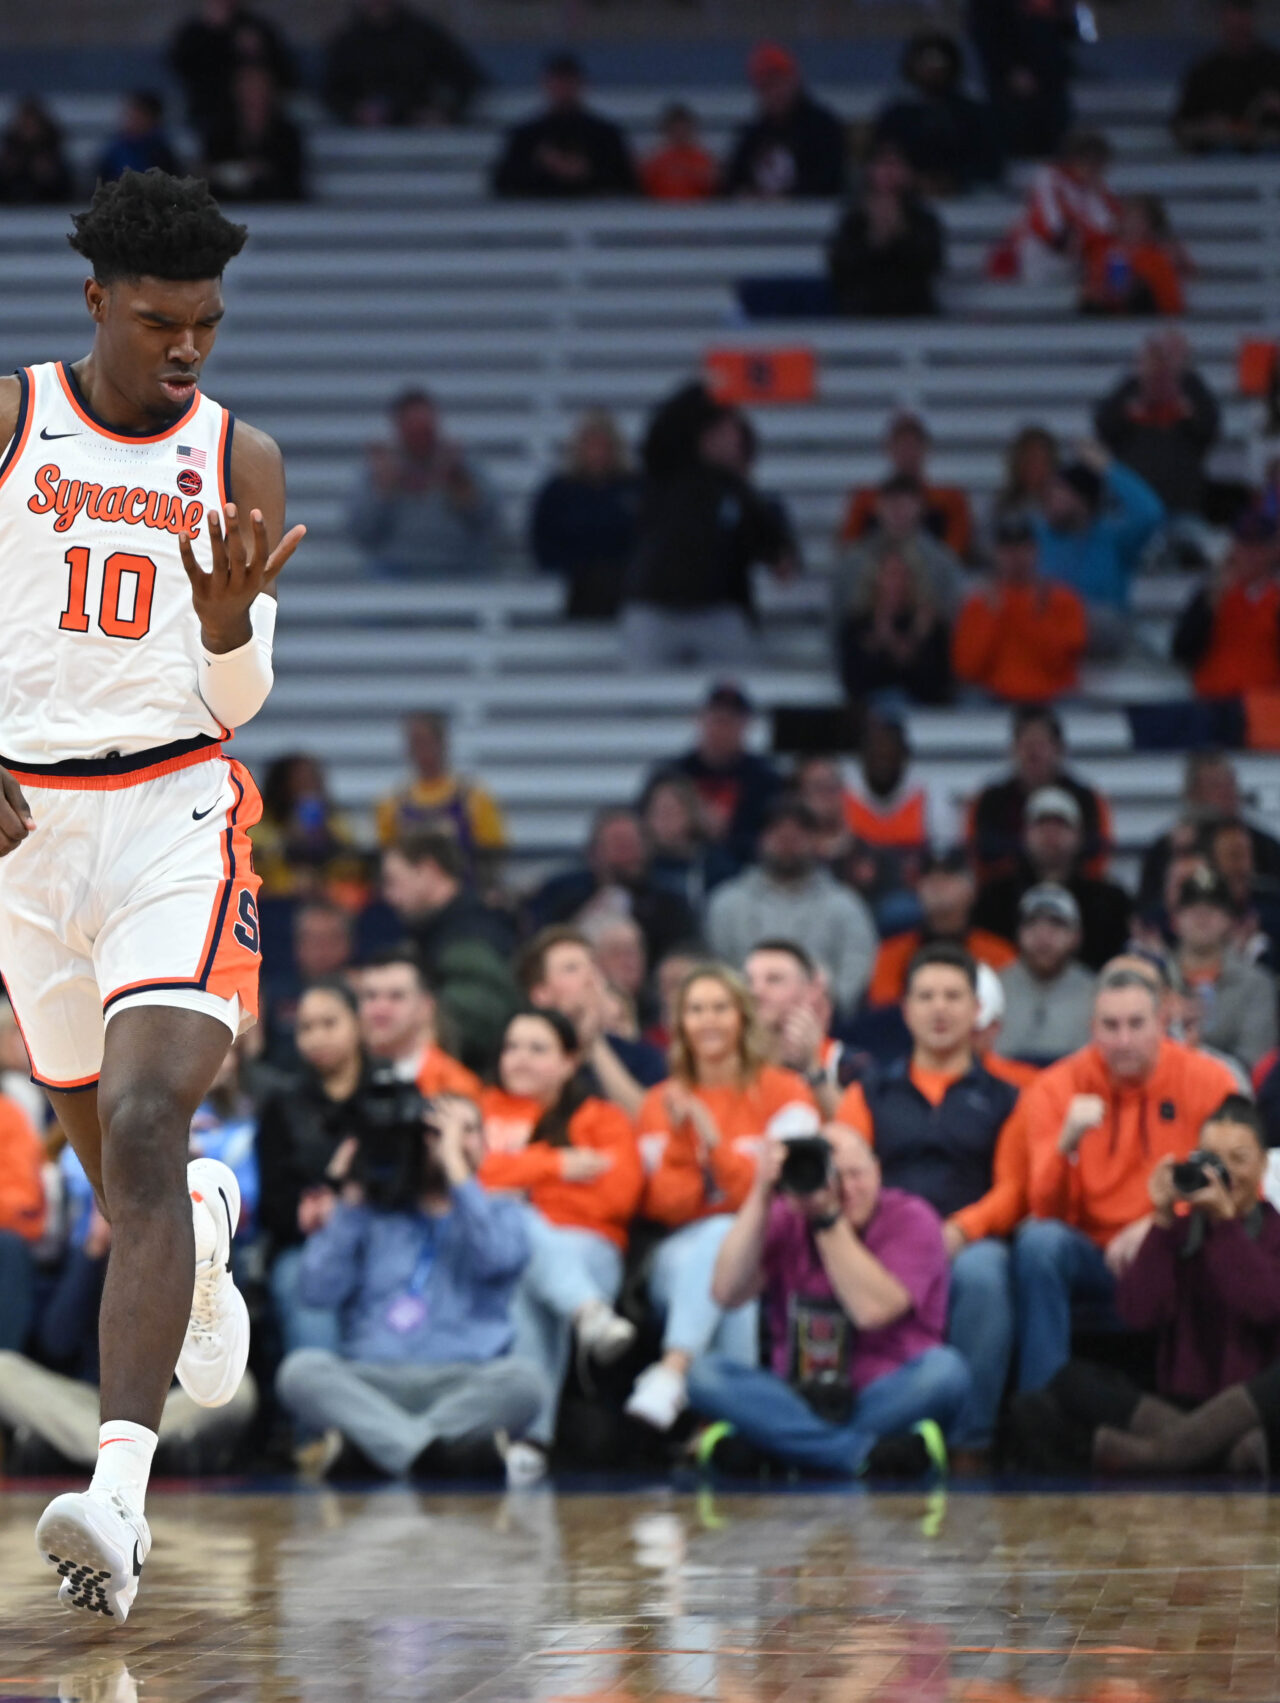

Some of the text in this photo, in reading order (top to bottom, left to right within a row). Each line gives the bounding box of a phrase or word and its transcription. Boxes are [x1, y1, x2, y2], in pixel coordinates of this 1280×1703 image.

[27, 463, 204, 540] Syracuse
[58, 546, 157, 641] 10
[233, 888, 260, 955] S
